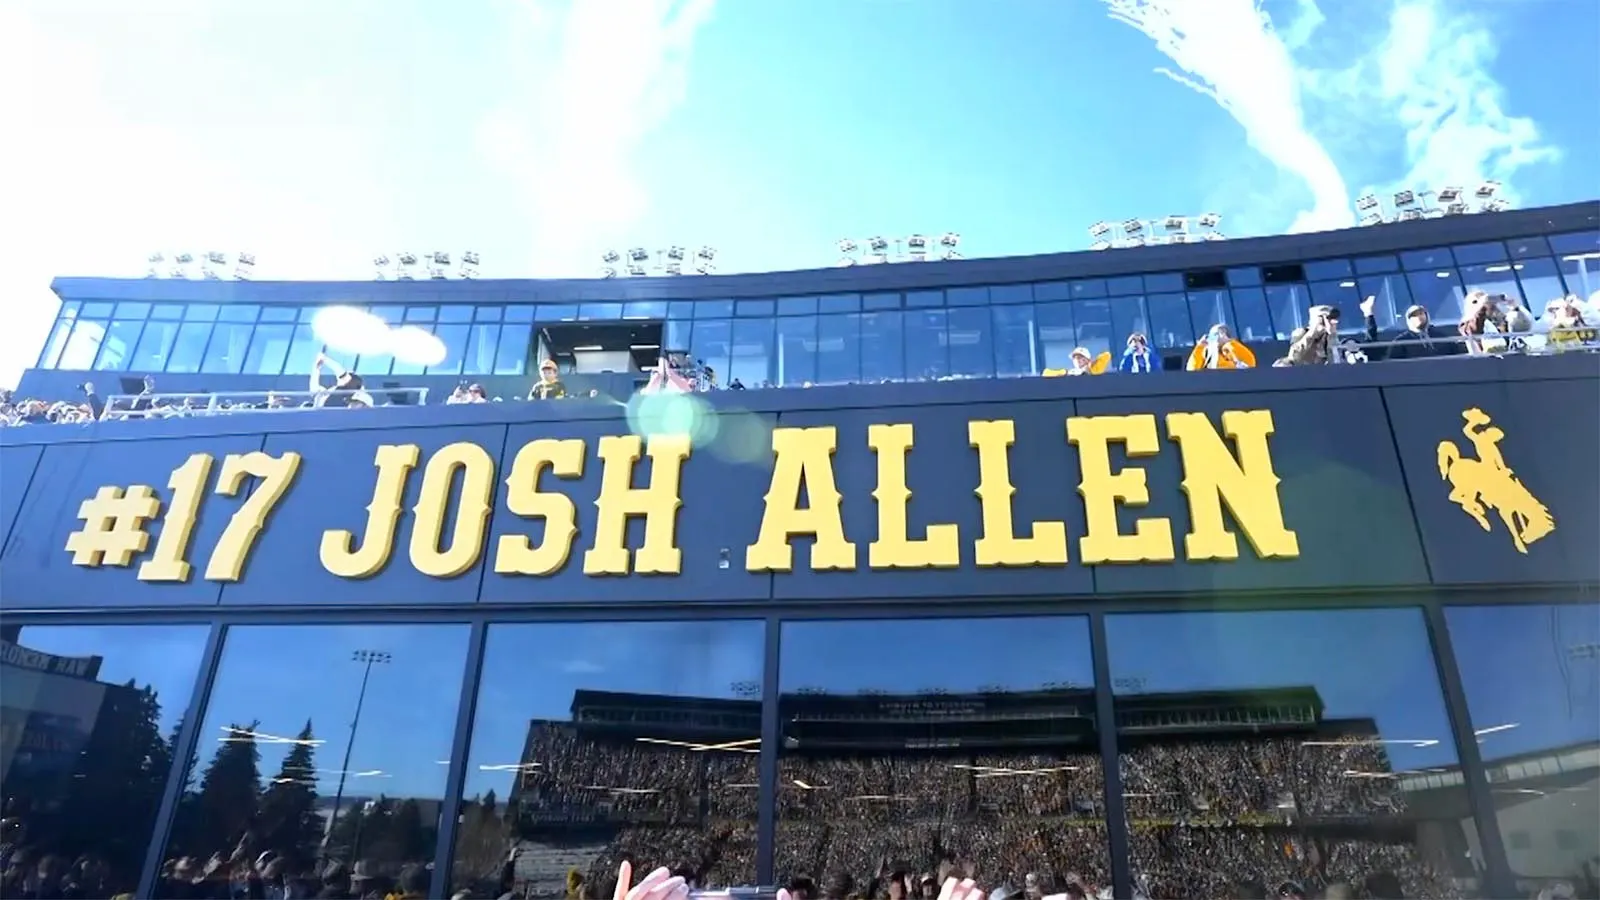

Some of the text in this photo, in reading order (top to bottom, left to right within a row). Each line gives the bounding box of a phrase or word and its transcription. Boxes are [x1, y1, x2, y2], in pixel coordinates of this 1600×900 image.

[65, 409, 1300, 582] #17 JOSH ALLEN
